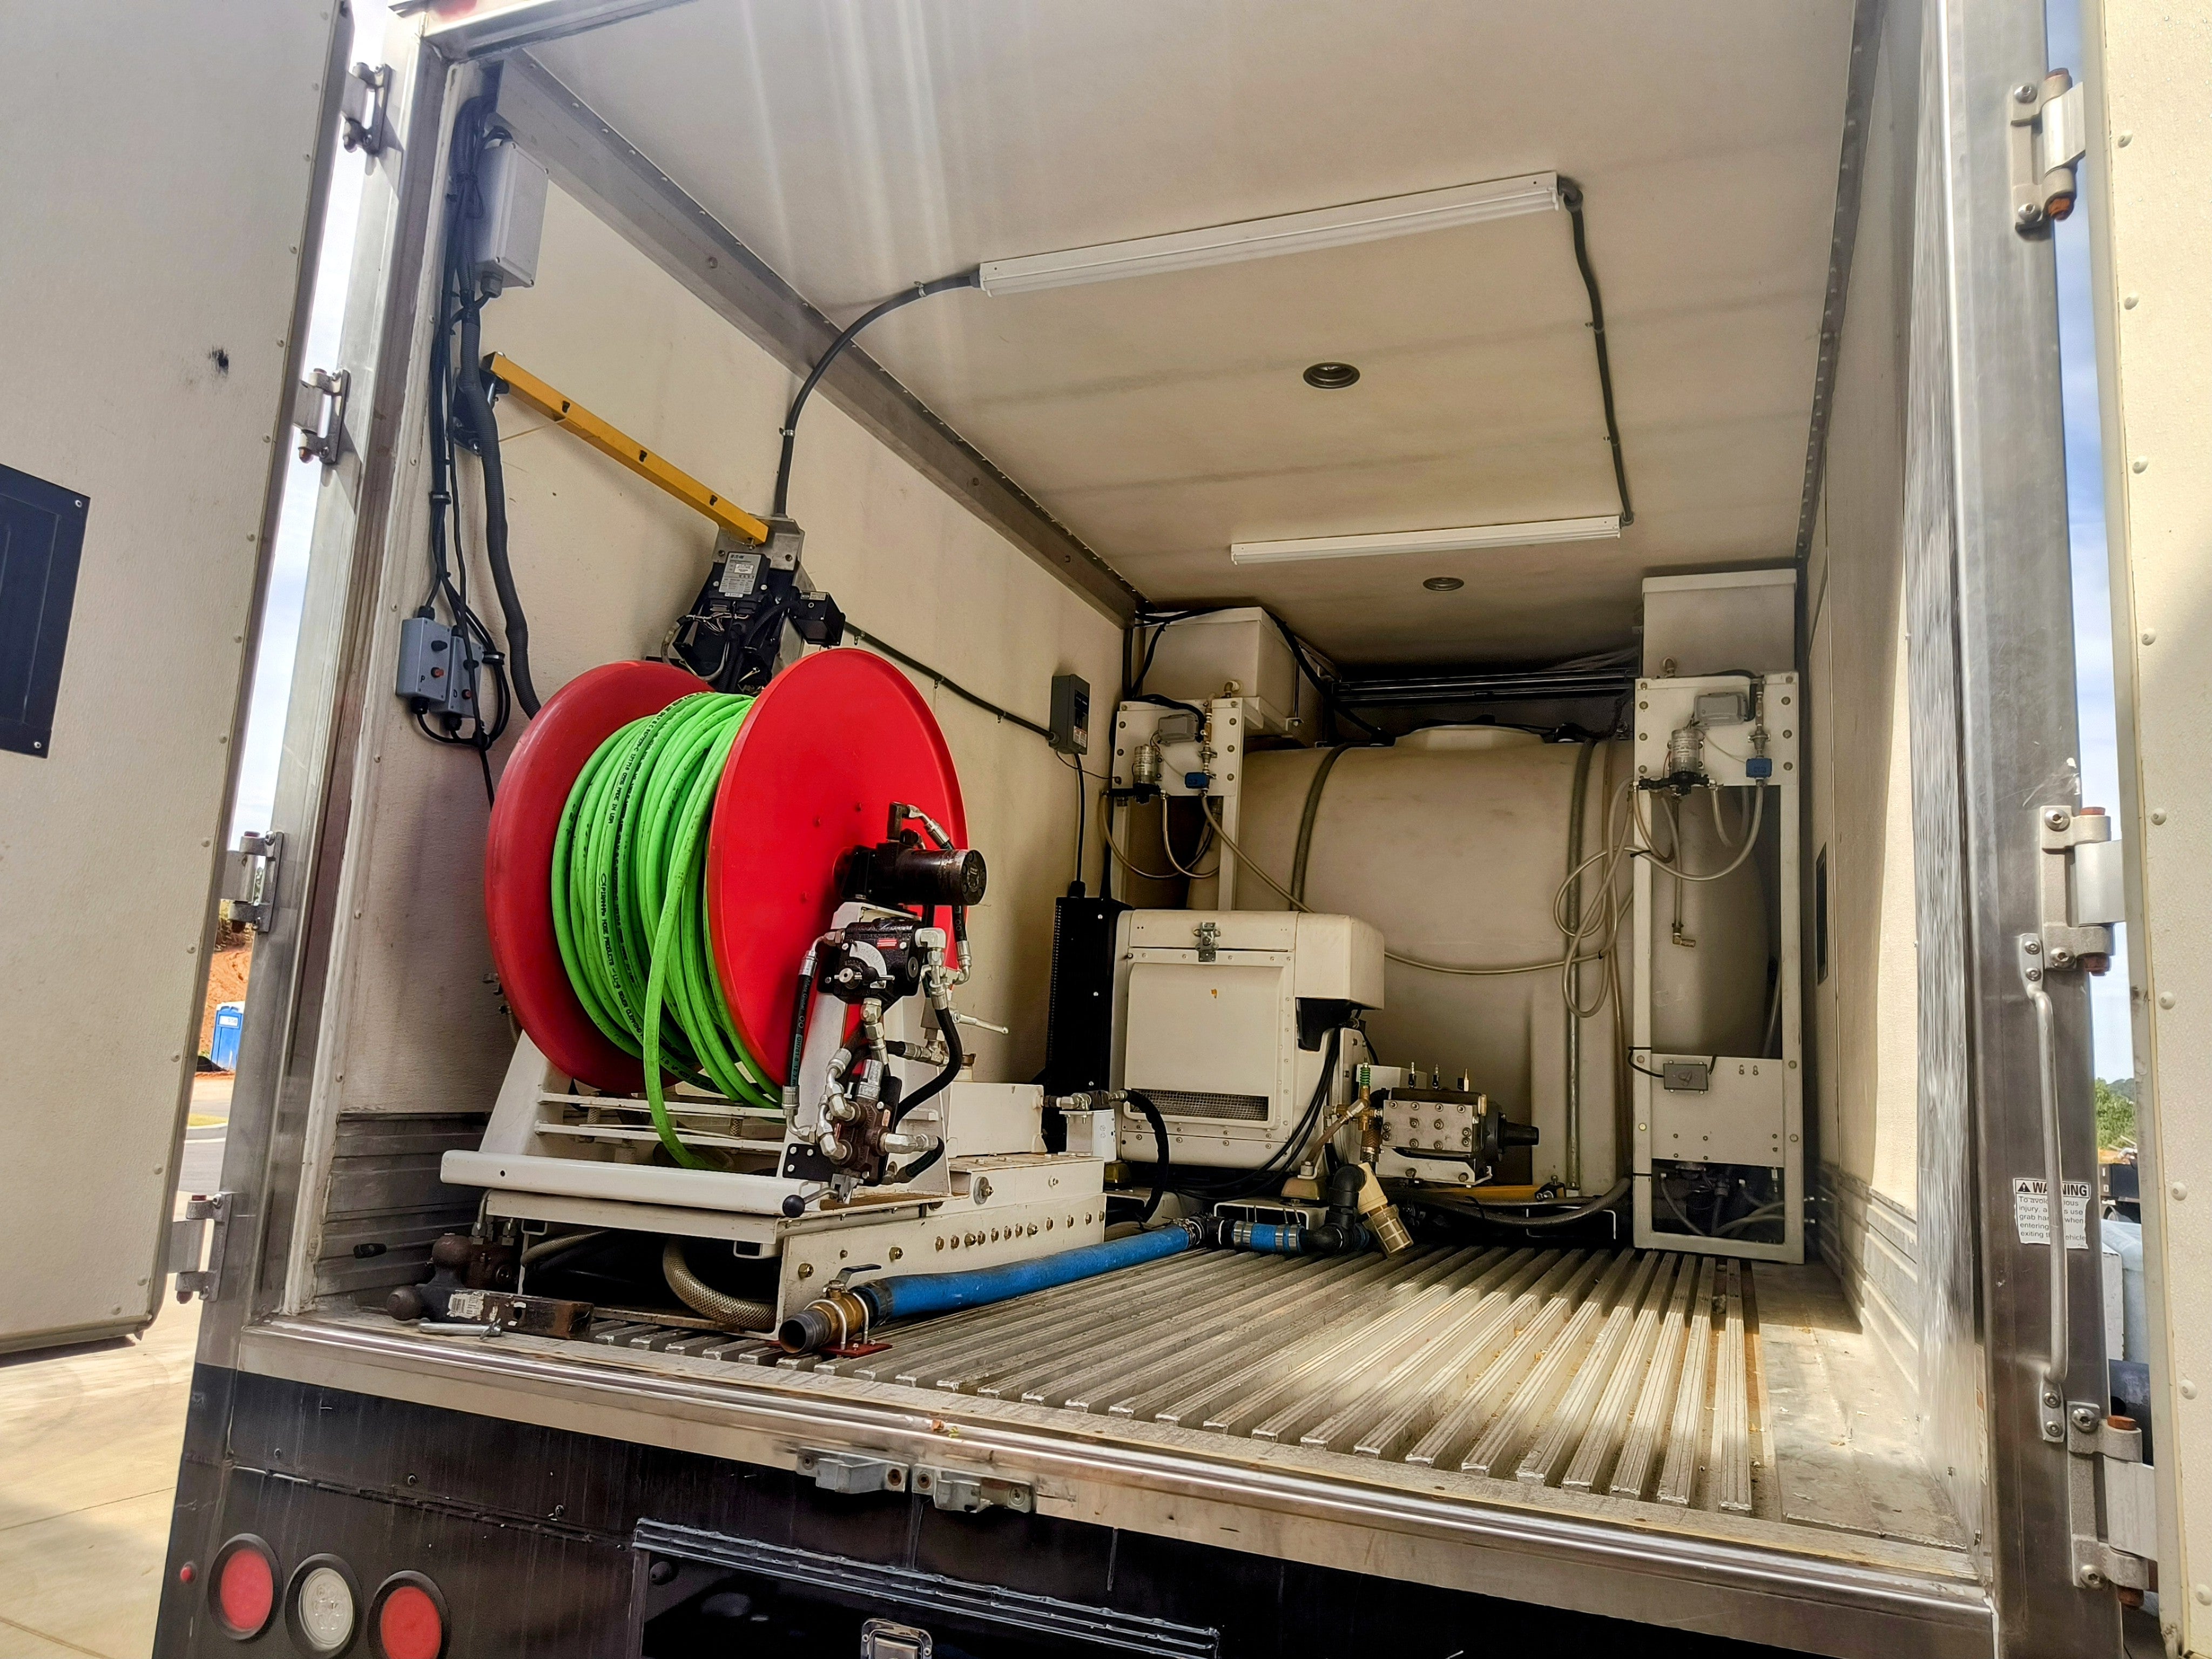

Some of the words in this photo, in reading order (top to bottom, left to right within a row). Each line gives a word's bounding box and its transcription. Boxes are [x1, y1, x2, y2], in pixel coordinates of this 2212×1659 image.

[614, 787, 622, 801] MADE
[2033, 1182, 2087, 1196] WANING
[2020, 1230, 2044, 1238] exiting
